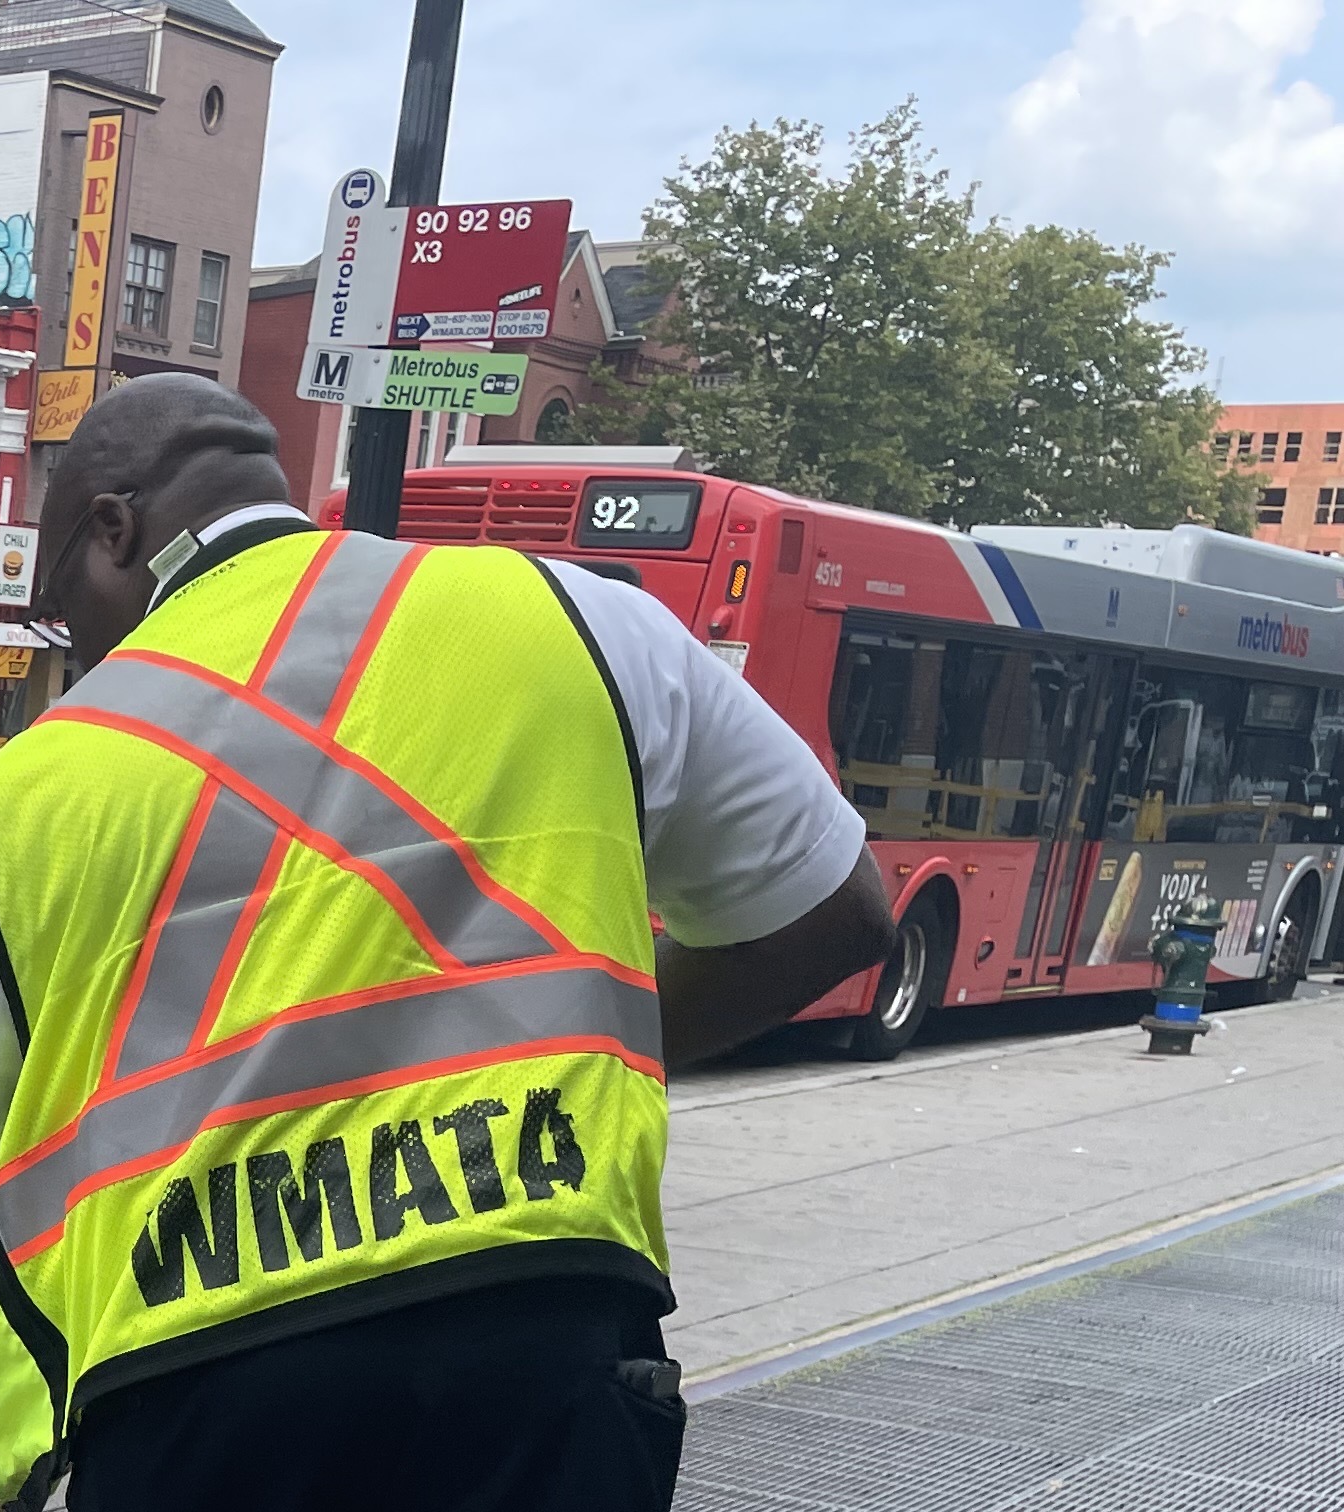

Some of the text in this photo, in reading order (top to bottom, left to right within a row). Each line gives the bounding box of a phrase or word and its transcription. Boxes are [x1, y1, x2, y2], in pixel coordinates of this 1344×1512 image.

[415, 206, 533, 234] 90 92 96
[72, 121, 118, 351] BEN'S
[411, 240, 443, 264] X3
[329, 215, 361, 337] metrobus
[397, 315, 422, 326] NEXT
[496, 323, 544, 336] 1001679
[497, 312, 520, 322] STOP
[397, 328, 418, 339] BUS
[389, 355, 480, 379] Metrobus
[38, 375, 82, 406] Chili
[307, 388, 345, 401] metro
[384, 384, 477, 409] SHUTTLE
[591, 496, 640, 530] 92
[3, 533, 29, 549] CHILI
[815, 561, 843, 588] 4513
[1237, 611, 1310, 658] metrobus
[131, 1087, 586, 1308] WMATA
